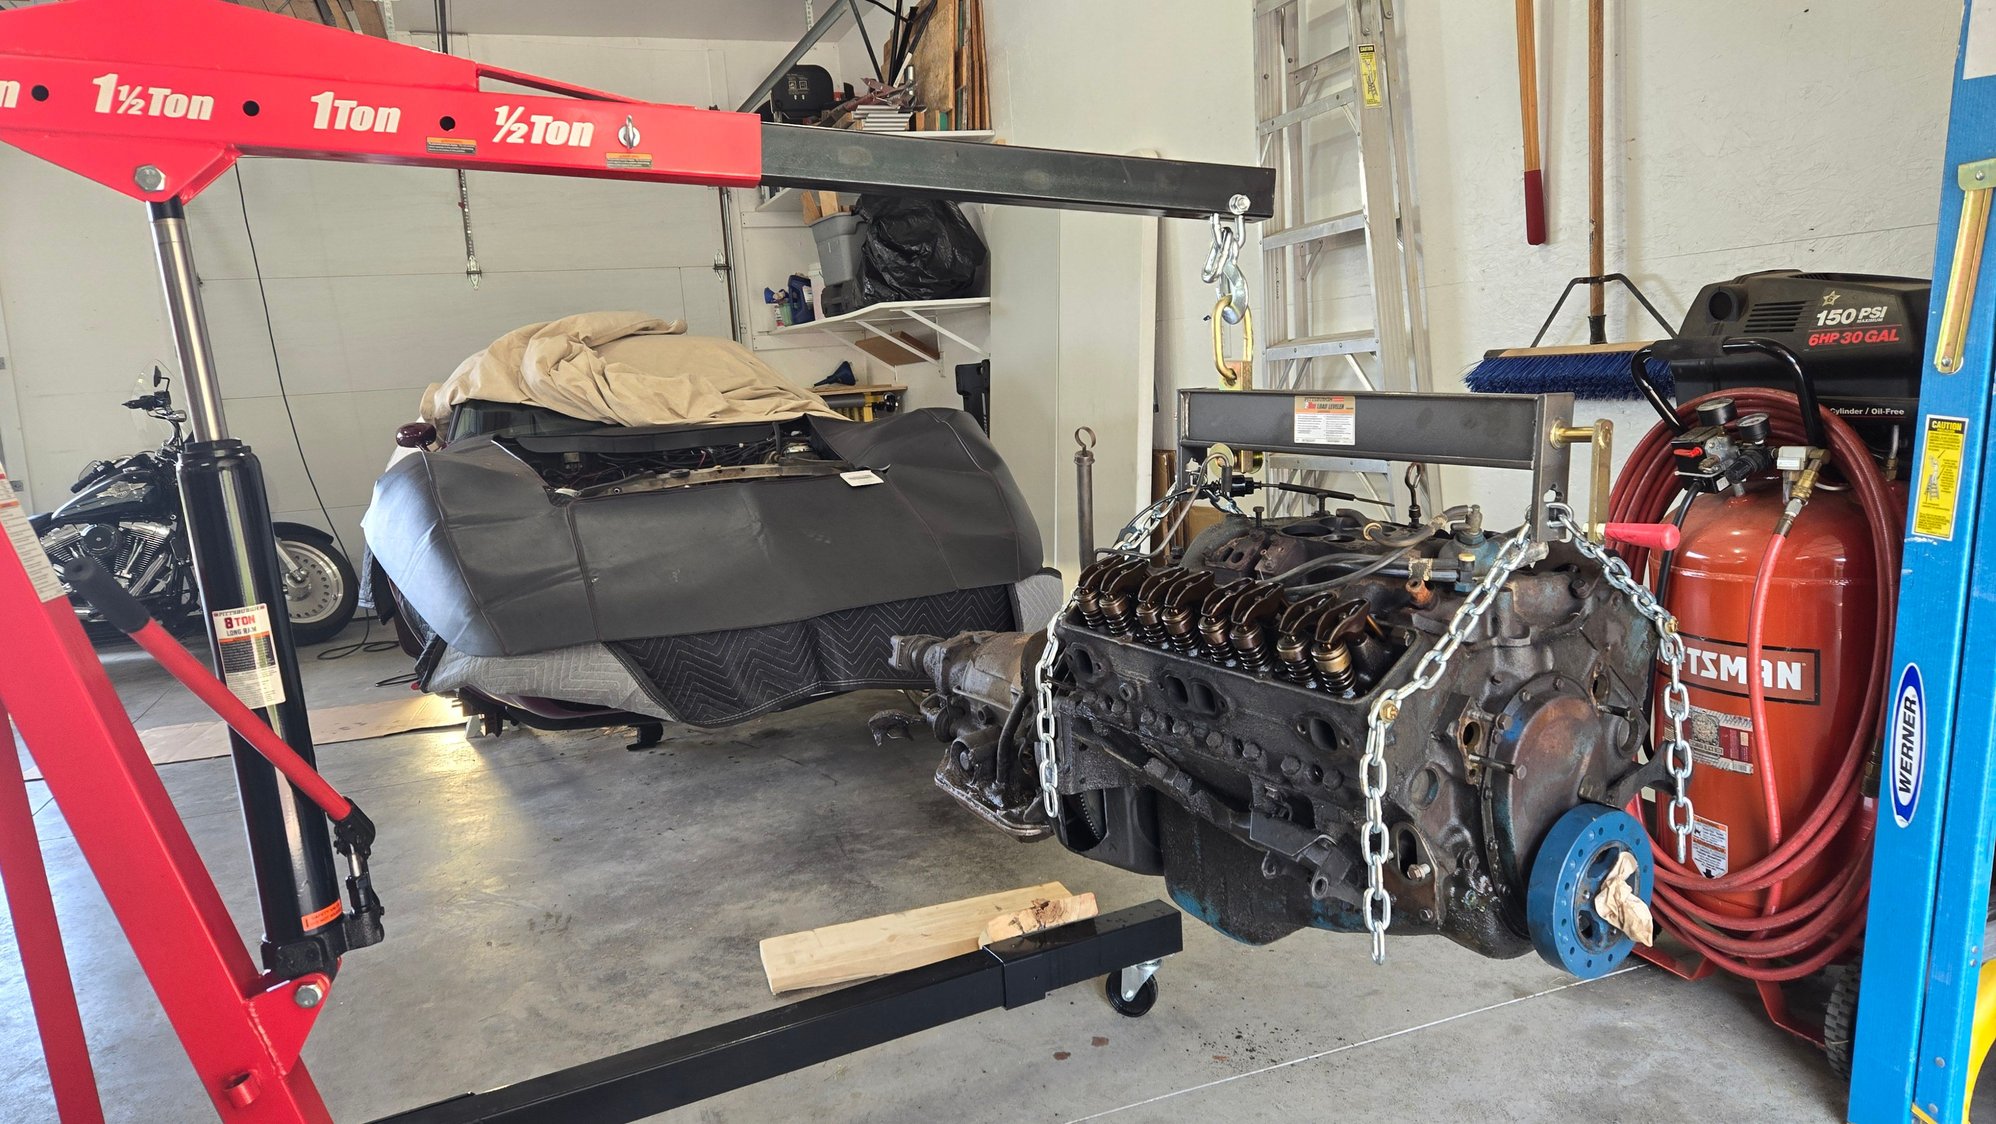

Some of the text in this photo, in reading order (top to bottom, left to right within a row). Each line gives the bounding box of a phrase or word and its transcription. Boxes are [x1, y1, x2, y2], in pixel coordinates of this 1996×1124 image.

[1816, 306, 1888, 326] 150 PSI
[1840, 331, 1863, 344] 30
[1864, 329, 1900, 343] GAL
[1871, 407, 1905, 416] Oil-Free
[1931, 420, 1963, 431] CAUTION
[224, 615, 256, 629] 8 TON
[226, 628, 242, 637] LONG
[1898, 695, 1917, 794] WERNER
